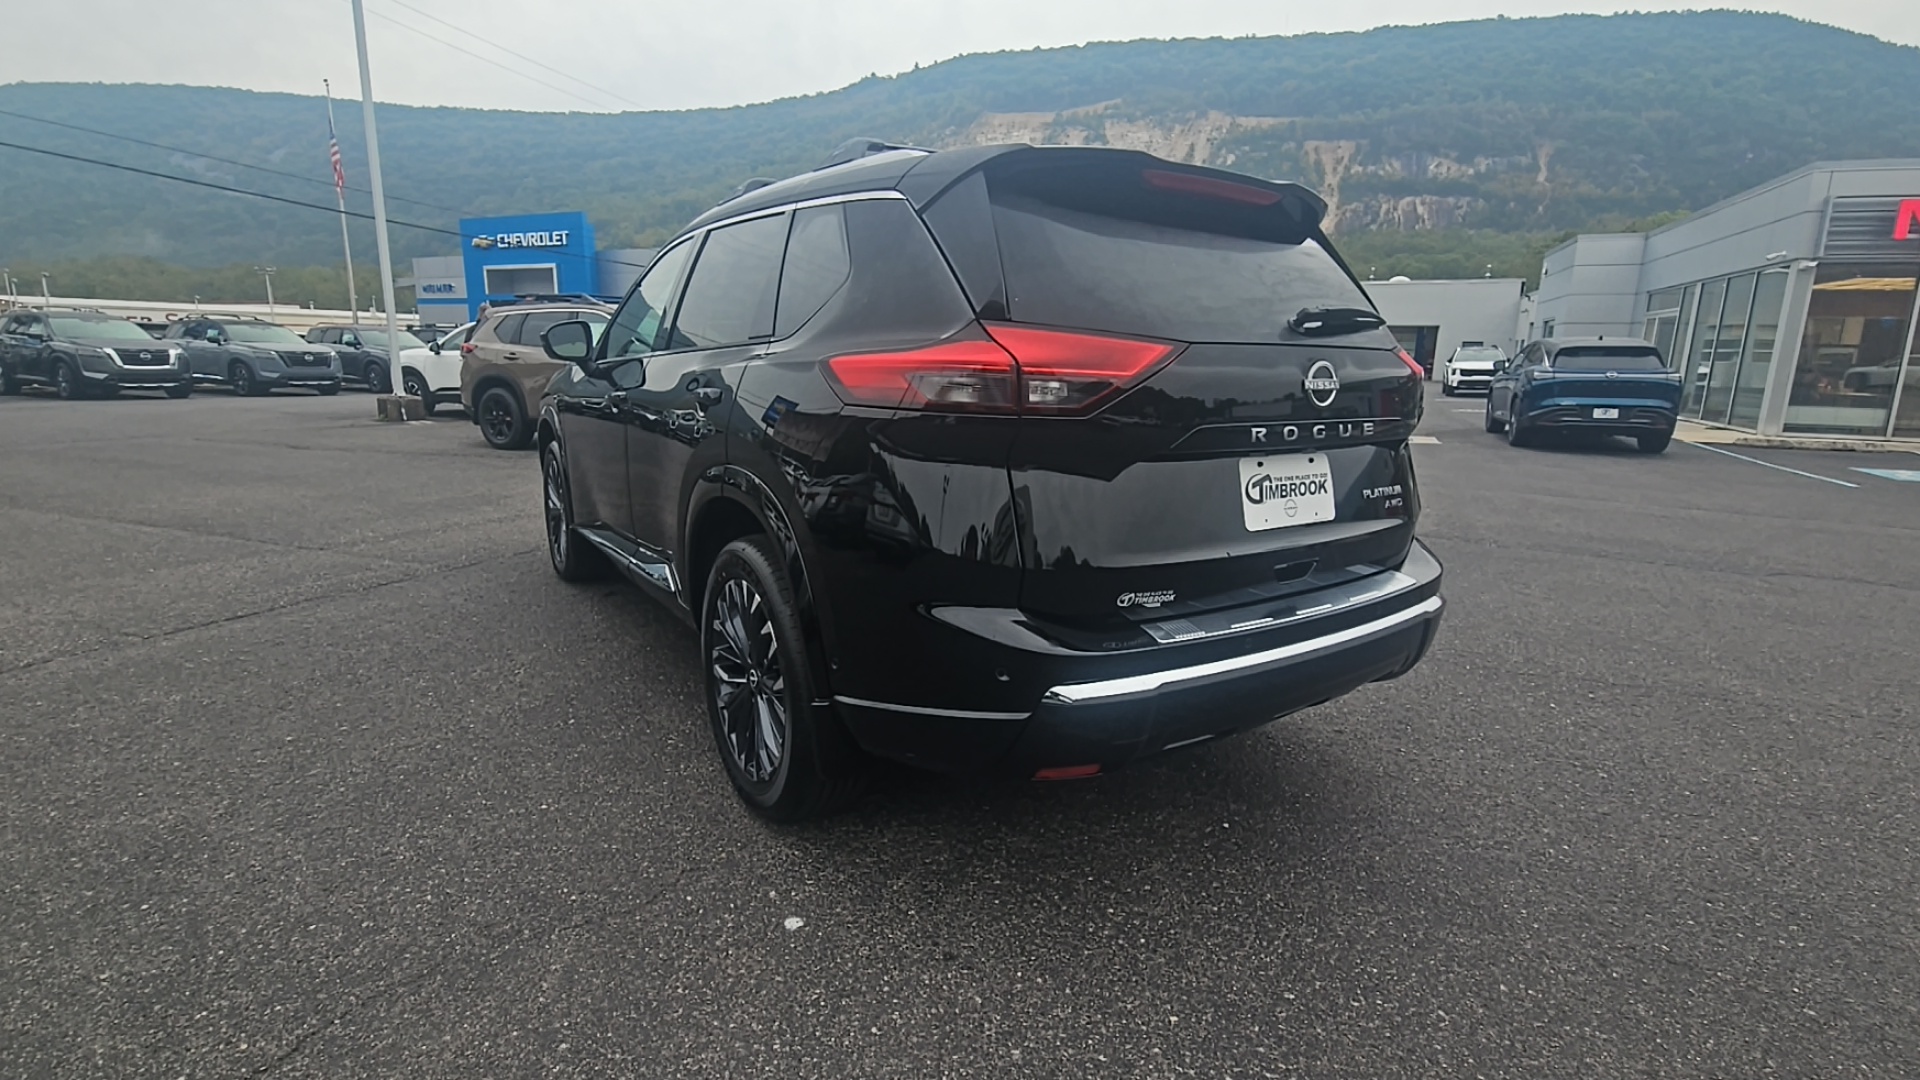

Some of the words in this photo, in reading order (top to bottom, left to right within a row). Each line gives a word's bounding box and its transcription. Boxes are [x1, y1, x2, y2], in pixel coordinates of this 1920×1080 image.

[497, 231, 569, 248] CHEVROLET
[1304, 379, 1340, 390] NISSAN
[1251, 422, 1375, 443] ROGUE
[1245, 473, 1328, 504] TIMBROOK
[1362, 484, 1402, 499] PLATINUM
